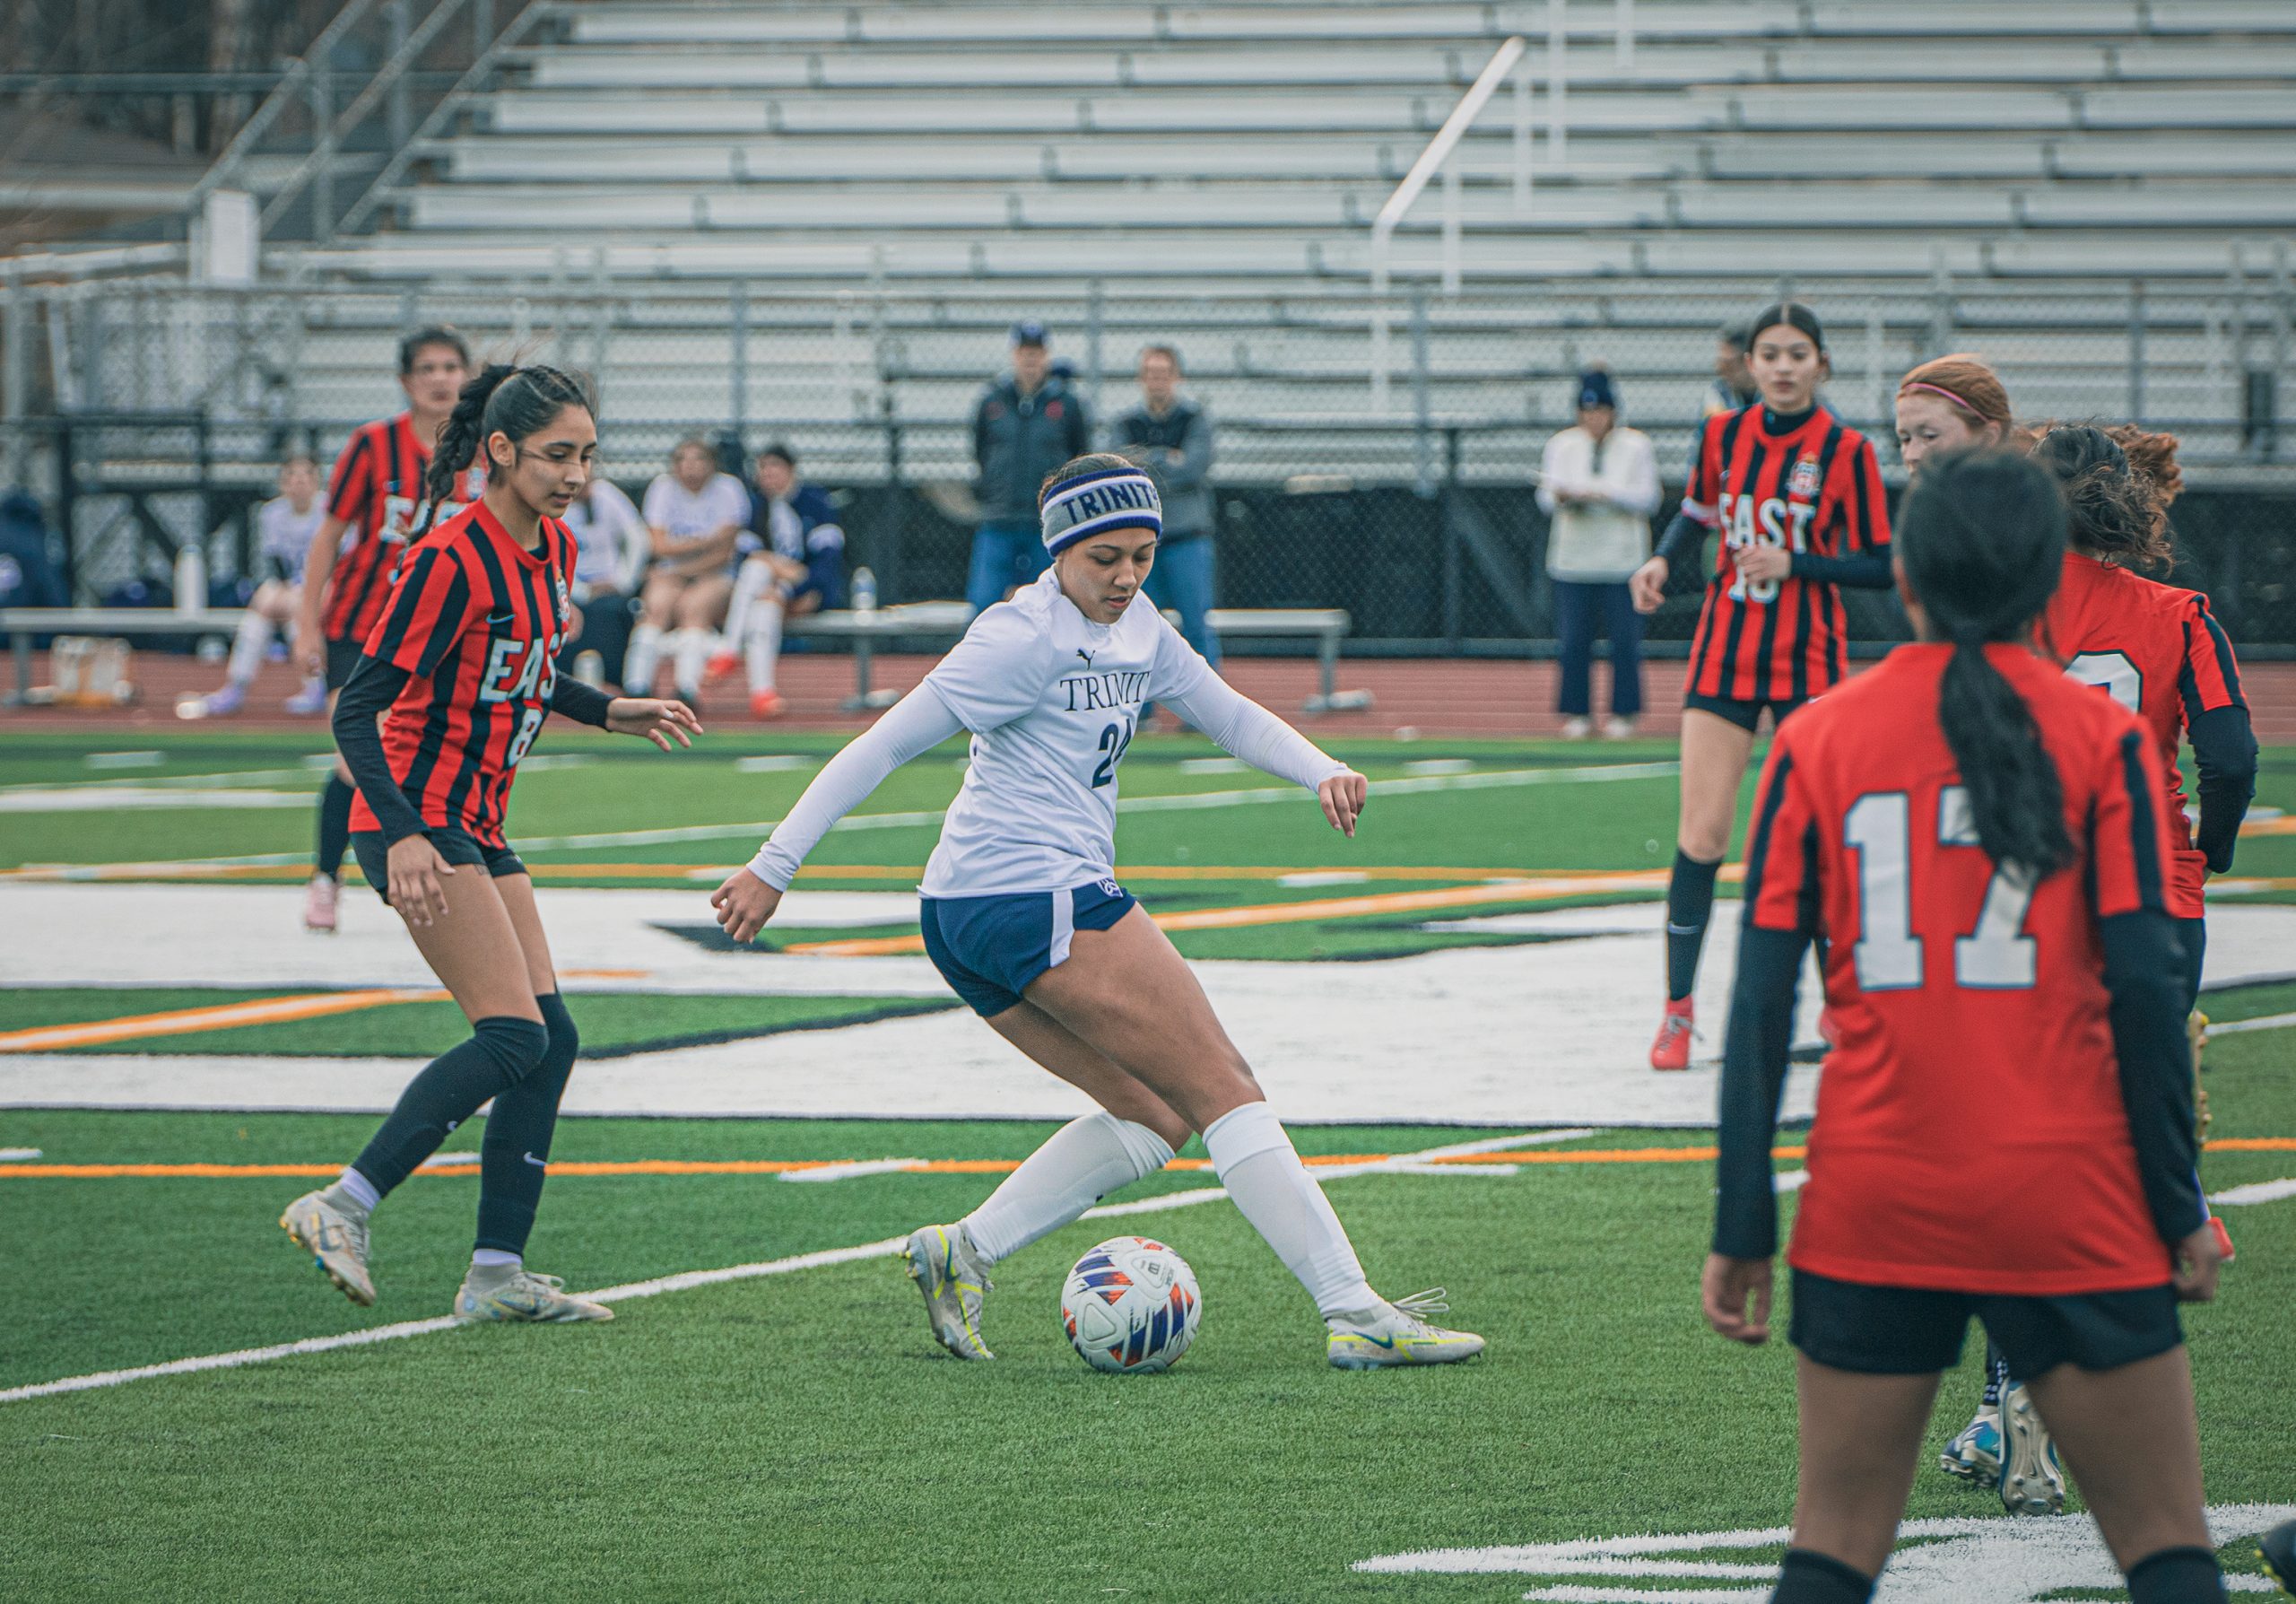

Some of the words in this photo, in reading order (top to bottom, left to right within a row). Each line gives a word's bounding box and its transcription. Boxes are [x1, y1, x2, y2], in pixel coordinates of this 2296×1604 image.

[1719, 493, 1815, 554] EAST
[508, 709, 543, 767] 8
[1844, 785, 2037, 990] 17
